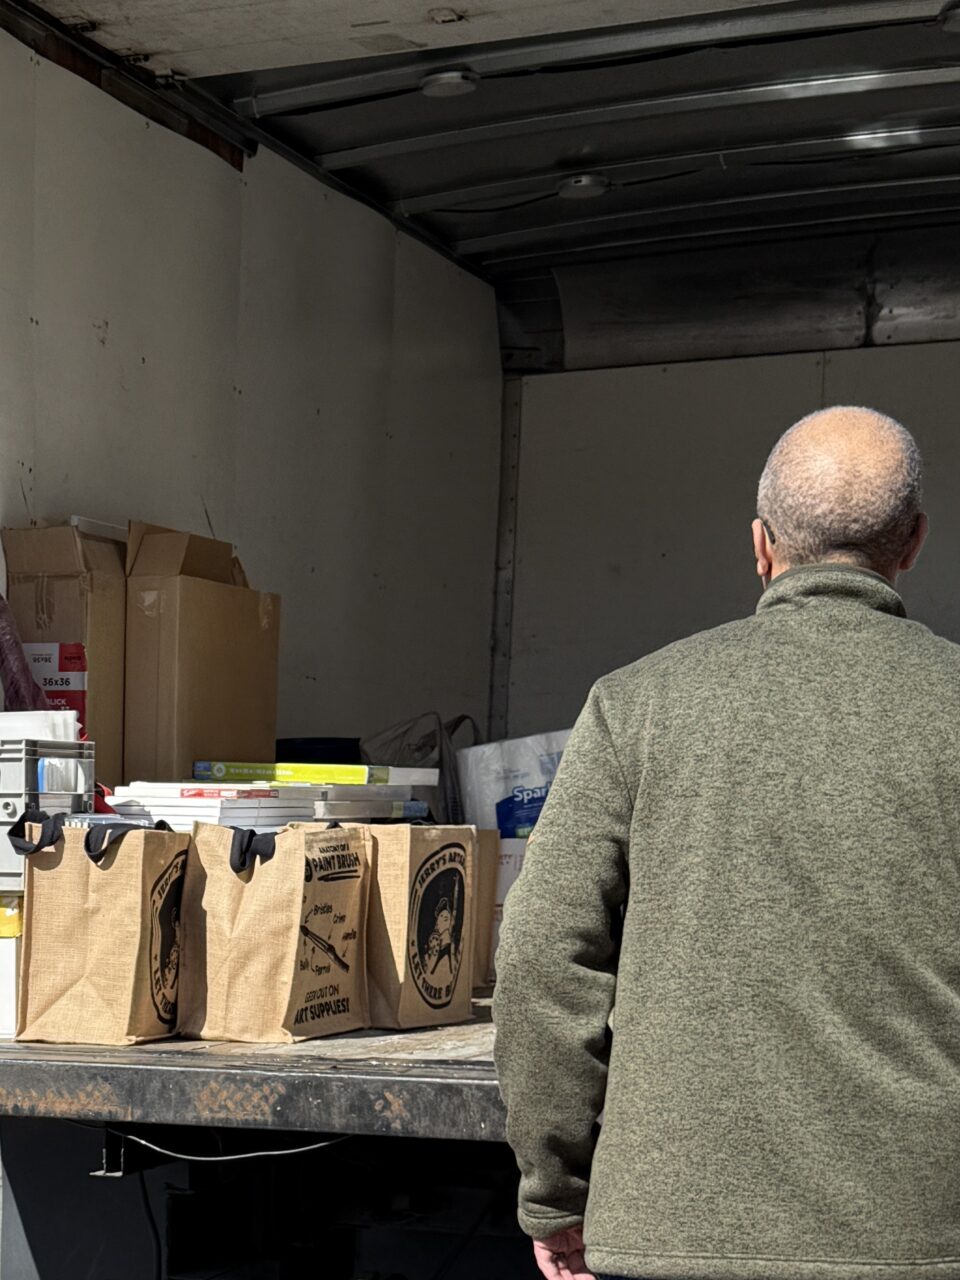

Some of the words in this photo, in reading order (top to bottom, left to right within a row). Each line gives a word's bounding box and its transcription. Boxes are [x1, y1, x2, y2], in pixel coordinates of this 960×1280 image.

[42, 678, 71, 687] 36x36
[313, 854, 337, 872] PAINT
[338, 852, 361, 869] BRUSH
[418, 853, 447, 889] JERRY'S
[411, 952, 422, 980] LET
[294, 1004, 310, 1026] ART
[310, 997, 350, 1021] SUPPLIES!
